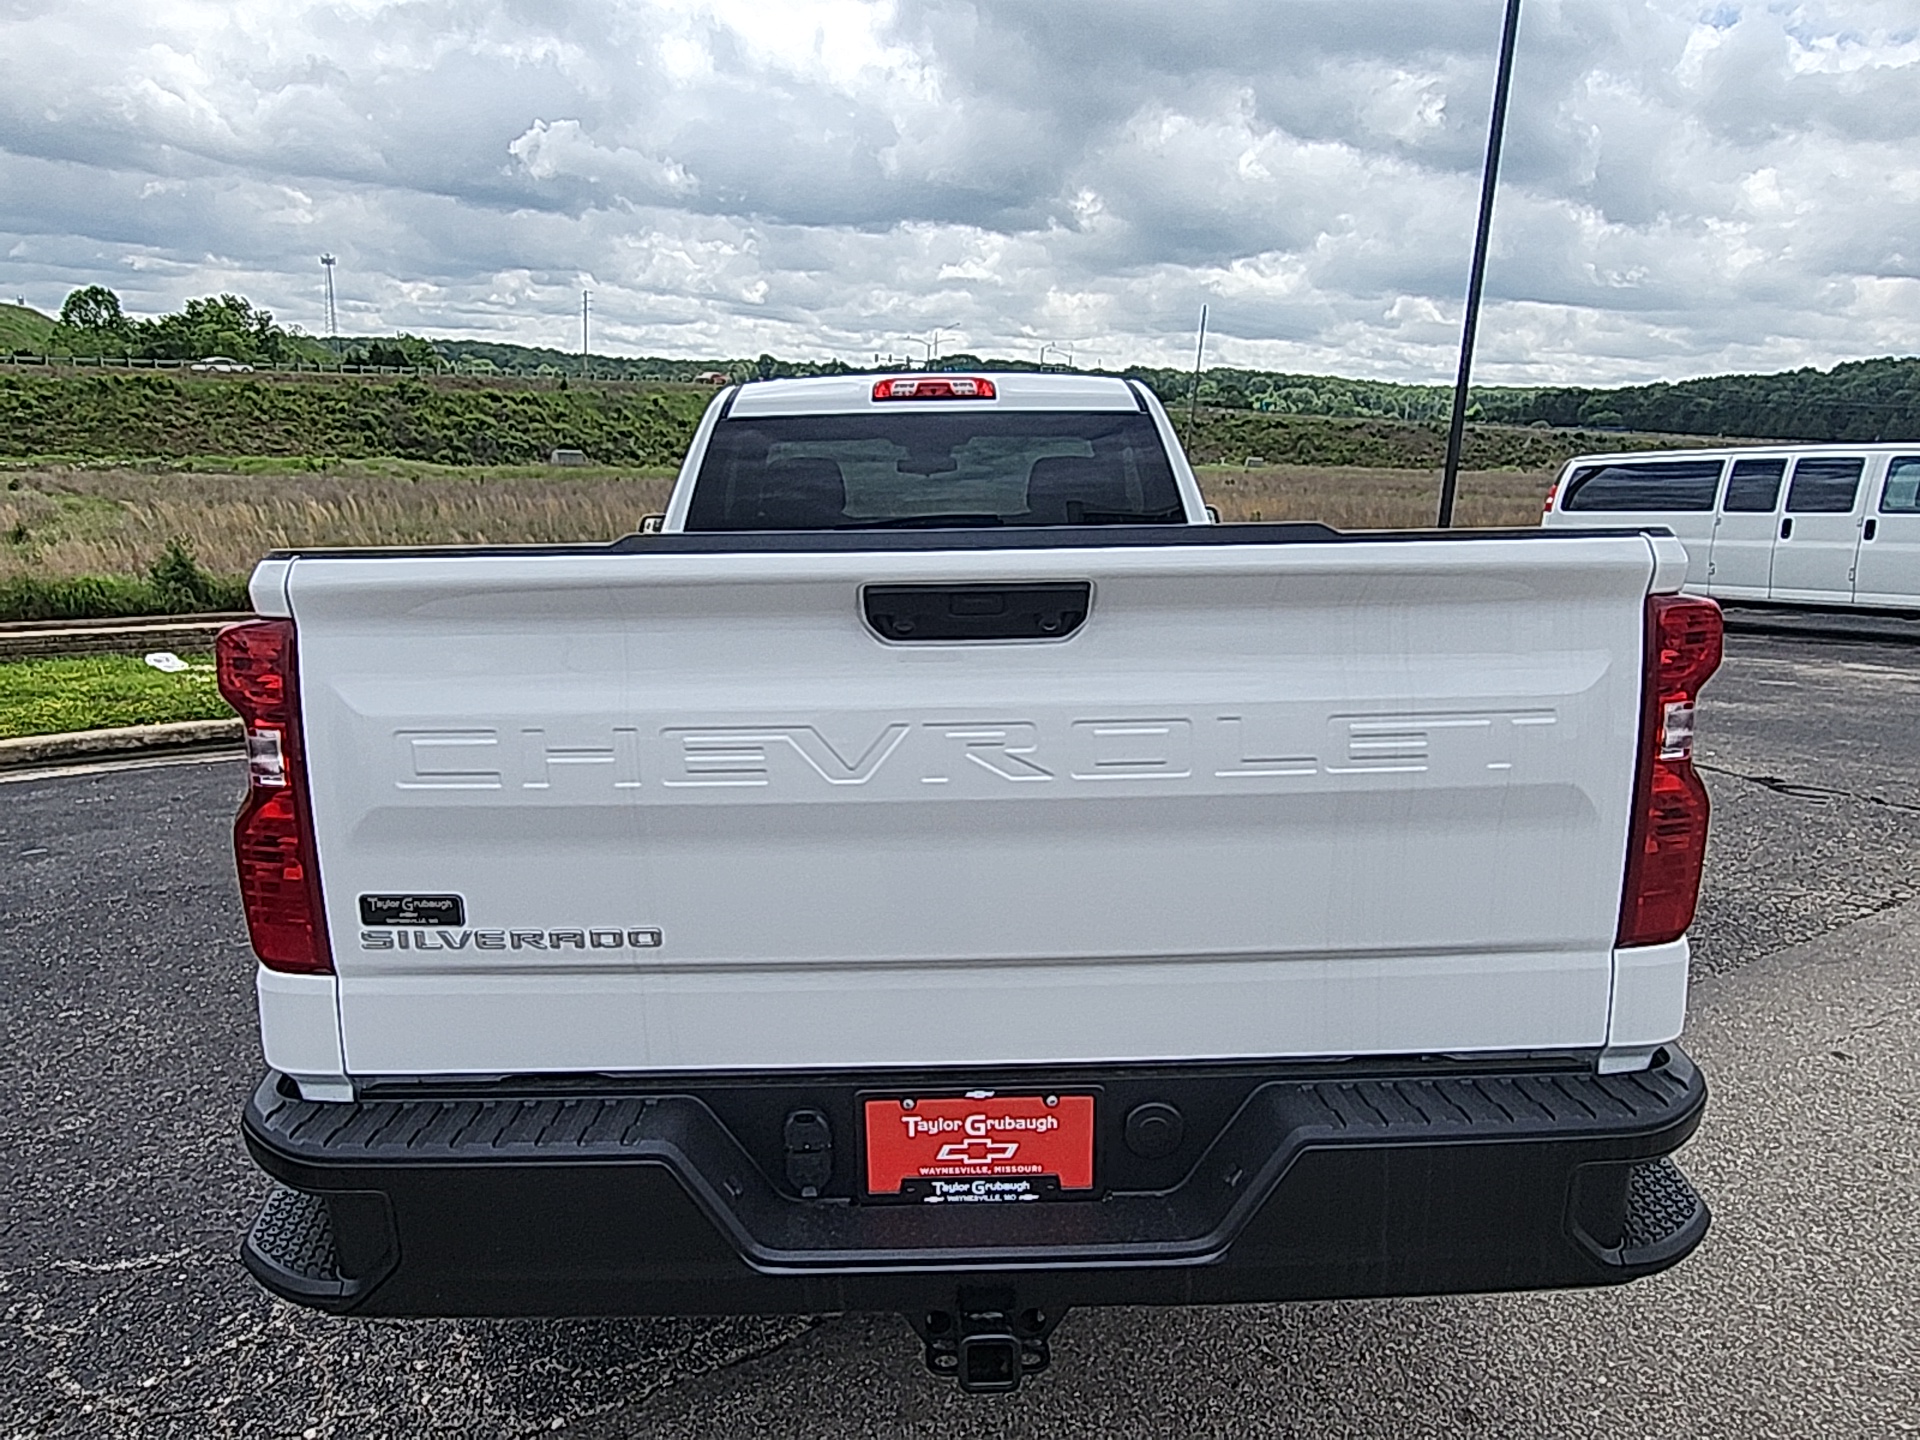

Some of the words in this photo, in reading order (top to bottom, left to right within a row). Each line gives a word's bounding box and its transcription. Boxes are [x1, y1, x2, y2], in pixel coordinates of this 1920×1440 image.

[394, 708, 1557, 789] CHEVROLET
[366, 897, 400, 911] Taylor
[401, 897, 453, 911] Grubaugh
[360, 927, 663, 950] SILVERADO
[901, 1116, 962, 1137] Taylor
[964, 1114, 1058, 1136] Grubaugh
[919, 1165, 992, 1176] WAYNESVILLE,
[993, 1164, 1042, 1174] MISSOURI
[931, 1181, 970, 1195] Taylor
[971, 1180, 1030, 1195] Grubaugh
